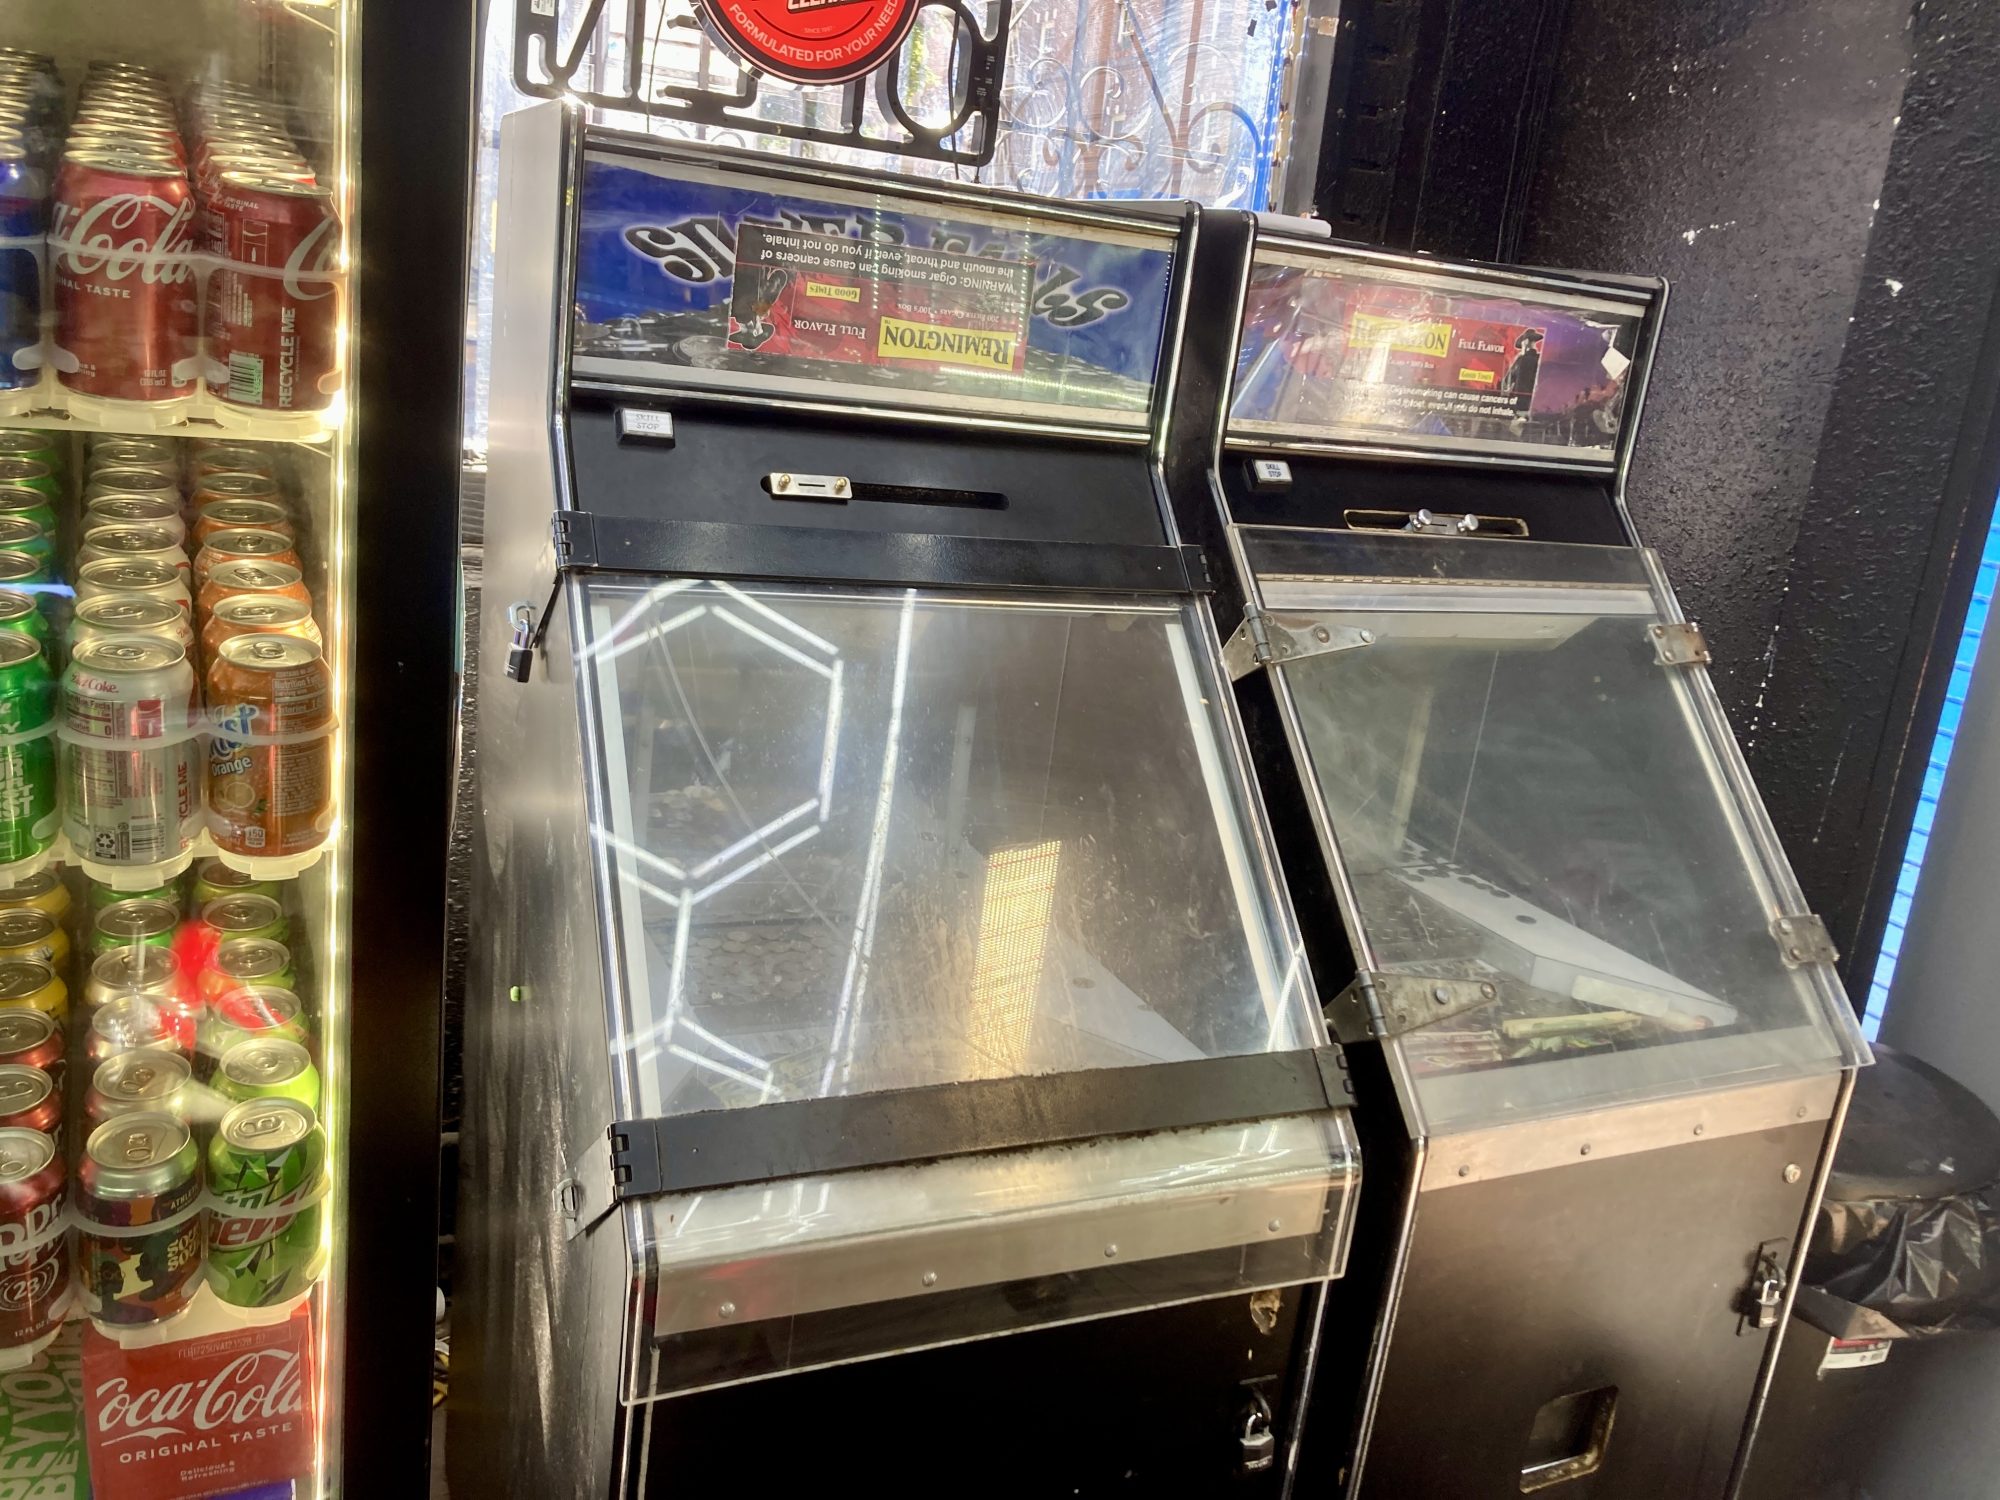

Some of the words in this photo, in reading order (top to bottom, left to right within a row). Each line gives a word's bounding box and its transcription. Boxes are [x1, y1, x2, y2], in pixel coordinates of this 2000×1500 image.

[729, 4, 814, 62] FORMULATED
[816, 47, 843, 62] FOR
[843, 28, 878, 55] YOUR
[763, 234, 800, 249] inhale.
[803, 240, 822, 250] not
[824, 243, 839, 254] do
[760, 249, 773, 260] of
[776, 251, 821, 265] cancers
[841, 245, 862, 257] you
[864, 248, 873, 260] if
[876, 249, 901, 261] even
[823, 257, 856, 270] cause
[904, 252, 939, 267] throat,
[941, 259, 961, 270] and
[859, 262, 881, 275] can
[882, 264, 927, 279] smoking
[963, 262, 996, 275] mouth
[998, 267, 1014, 279] the
[929, 271, 958, 286] Cigar
[85, 284, 131, 299] TASTE
[960, 277, 1015, 296] WARNING:
[281, 307, 296, 333] ME
[883, 325, 1011, 365] REMINGTON
[279, 335, 294, 407] RECYCLE
[1444, 390, 1458, 398] can
[1459, 391, 1480, 401] cause
[1481, 394, 1509, 405] cancers
[1509, 396, 1518, 405] of
[1468, 404, 1478, 413] do
[1479, 405, 1491, 414] not
[636, 413, 660, 422] SKILL
[177, 761, 188, 786] ME
[211, 756, 253, 777] Orange
[14, 1277, 40, 1301] 23
[119, 1439, 222, 1464] ORIGINAL
[230, 1423, 293, 1444] TASTE
[180, 1463, 225, 1477] Delicious
